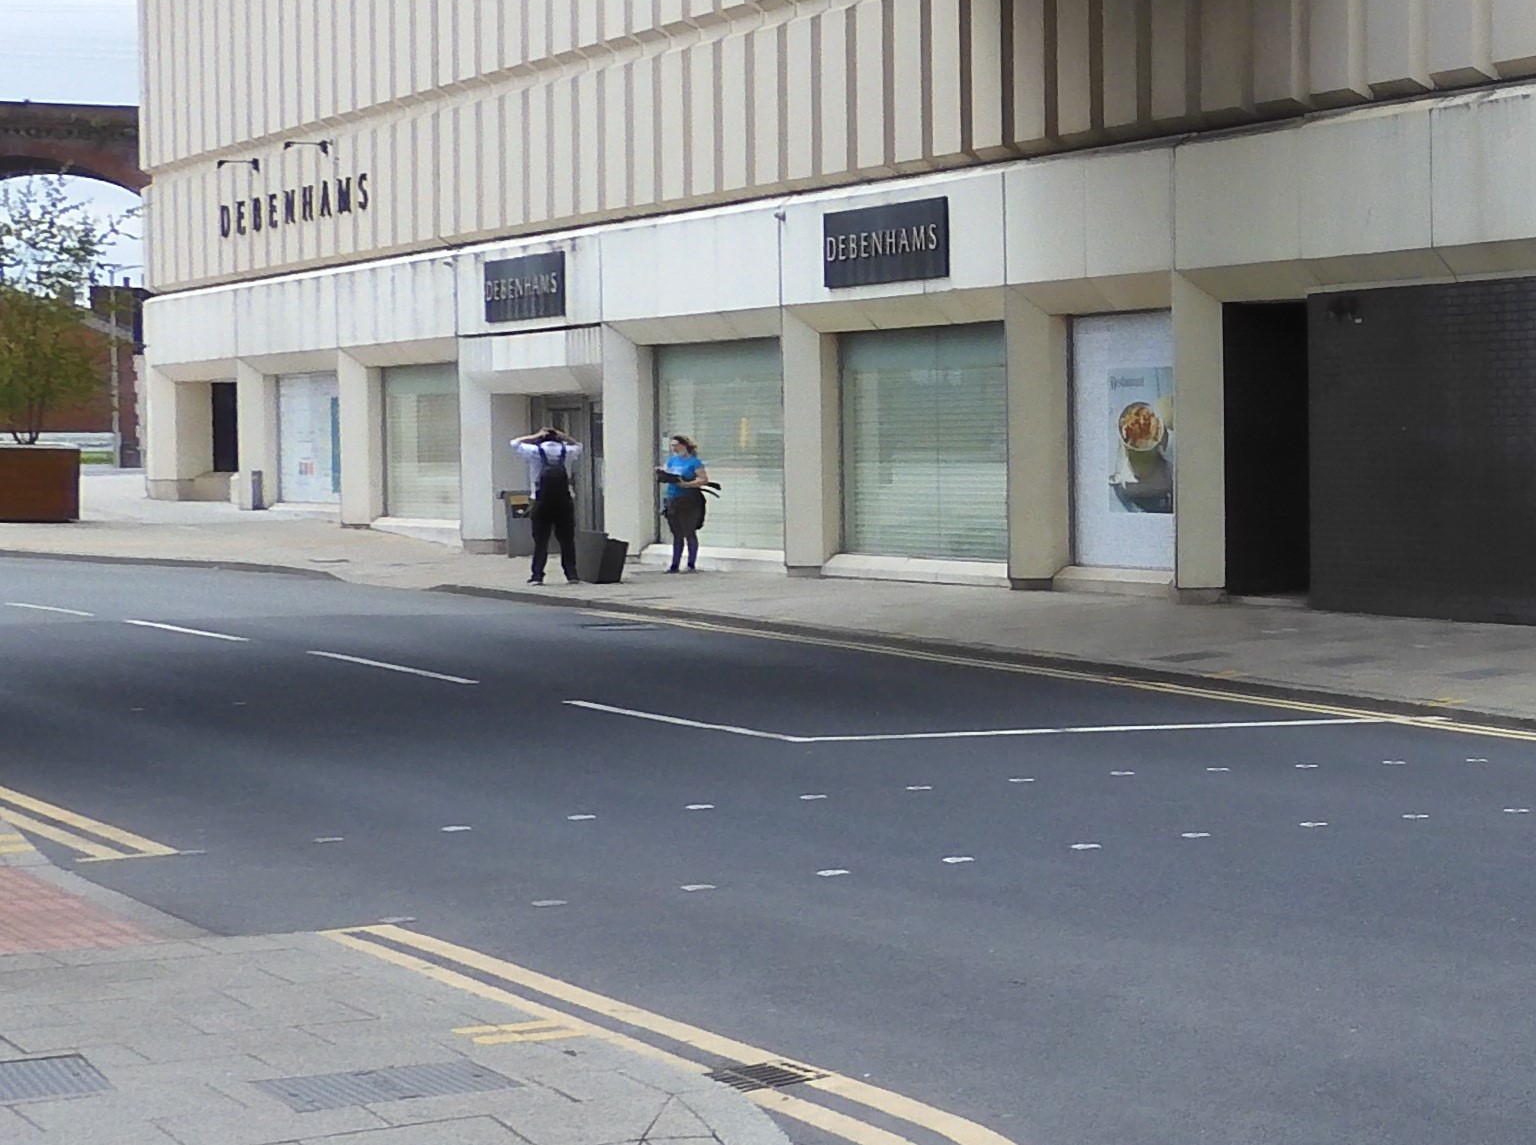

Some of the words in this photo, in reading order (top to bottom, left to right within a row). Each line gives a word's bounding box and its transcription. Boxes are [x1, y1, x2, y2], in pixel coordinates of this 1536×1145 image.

[220, 172, 369, 239] DEBENHAMS
[826, 223, 938, 262] DEBENHAMS
[486, 271, 558, 302] DEBENHAMS
